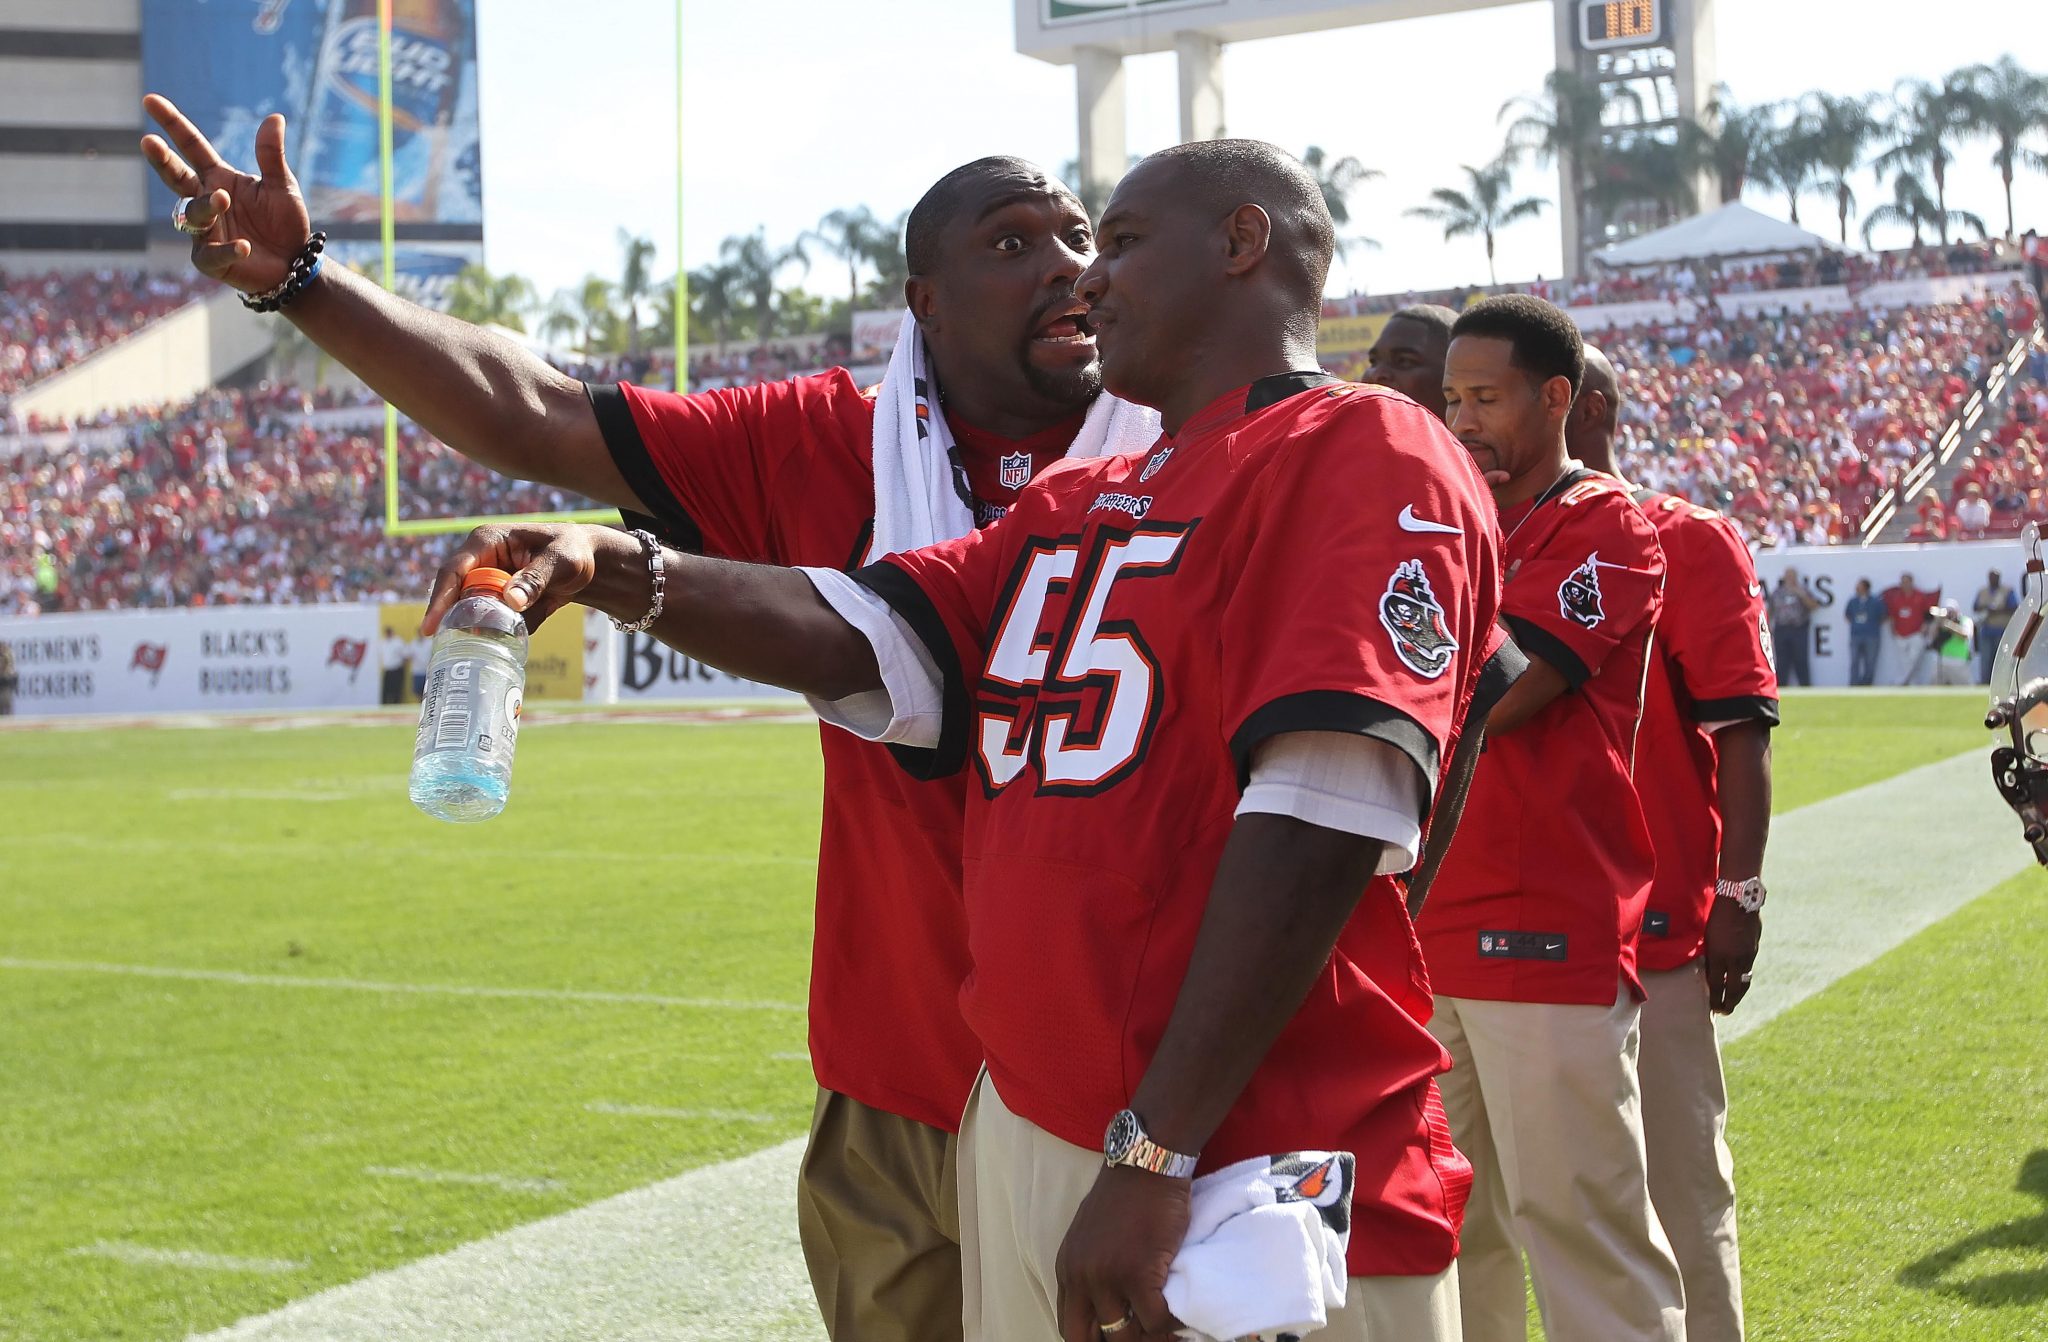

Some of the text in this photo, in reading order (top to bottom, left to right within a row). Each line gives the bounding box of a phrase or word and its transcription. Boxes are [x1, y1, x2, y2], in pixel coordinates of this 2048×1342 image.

[1604, 0, 1652, 39] 10
[1005, 468, 1027, 485] NFL
[201, 629, 288, 658] BLACK'S
[451, 661, 471, 680] G
[973, 518, 1203, 800] 55
